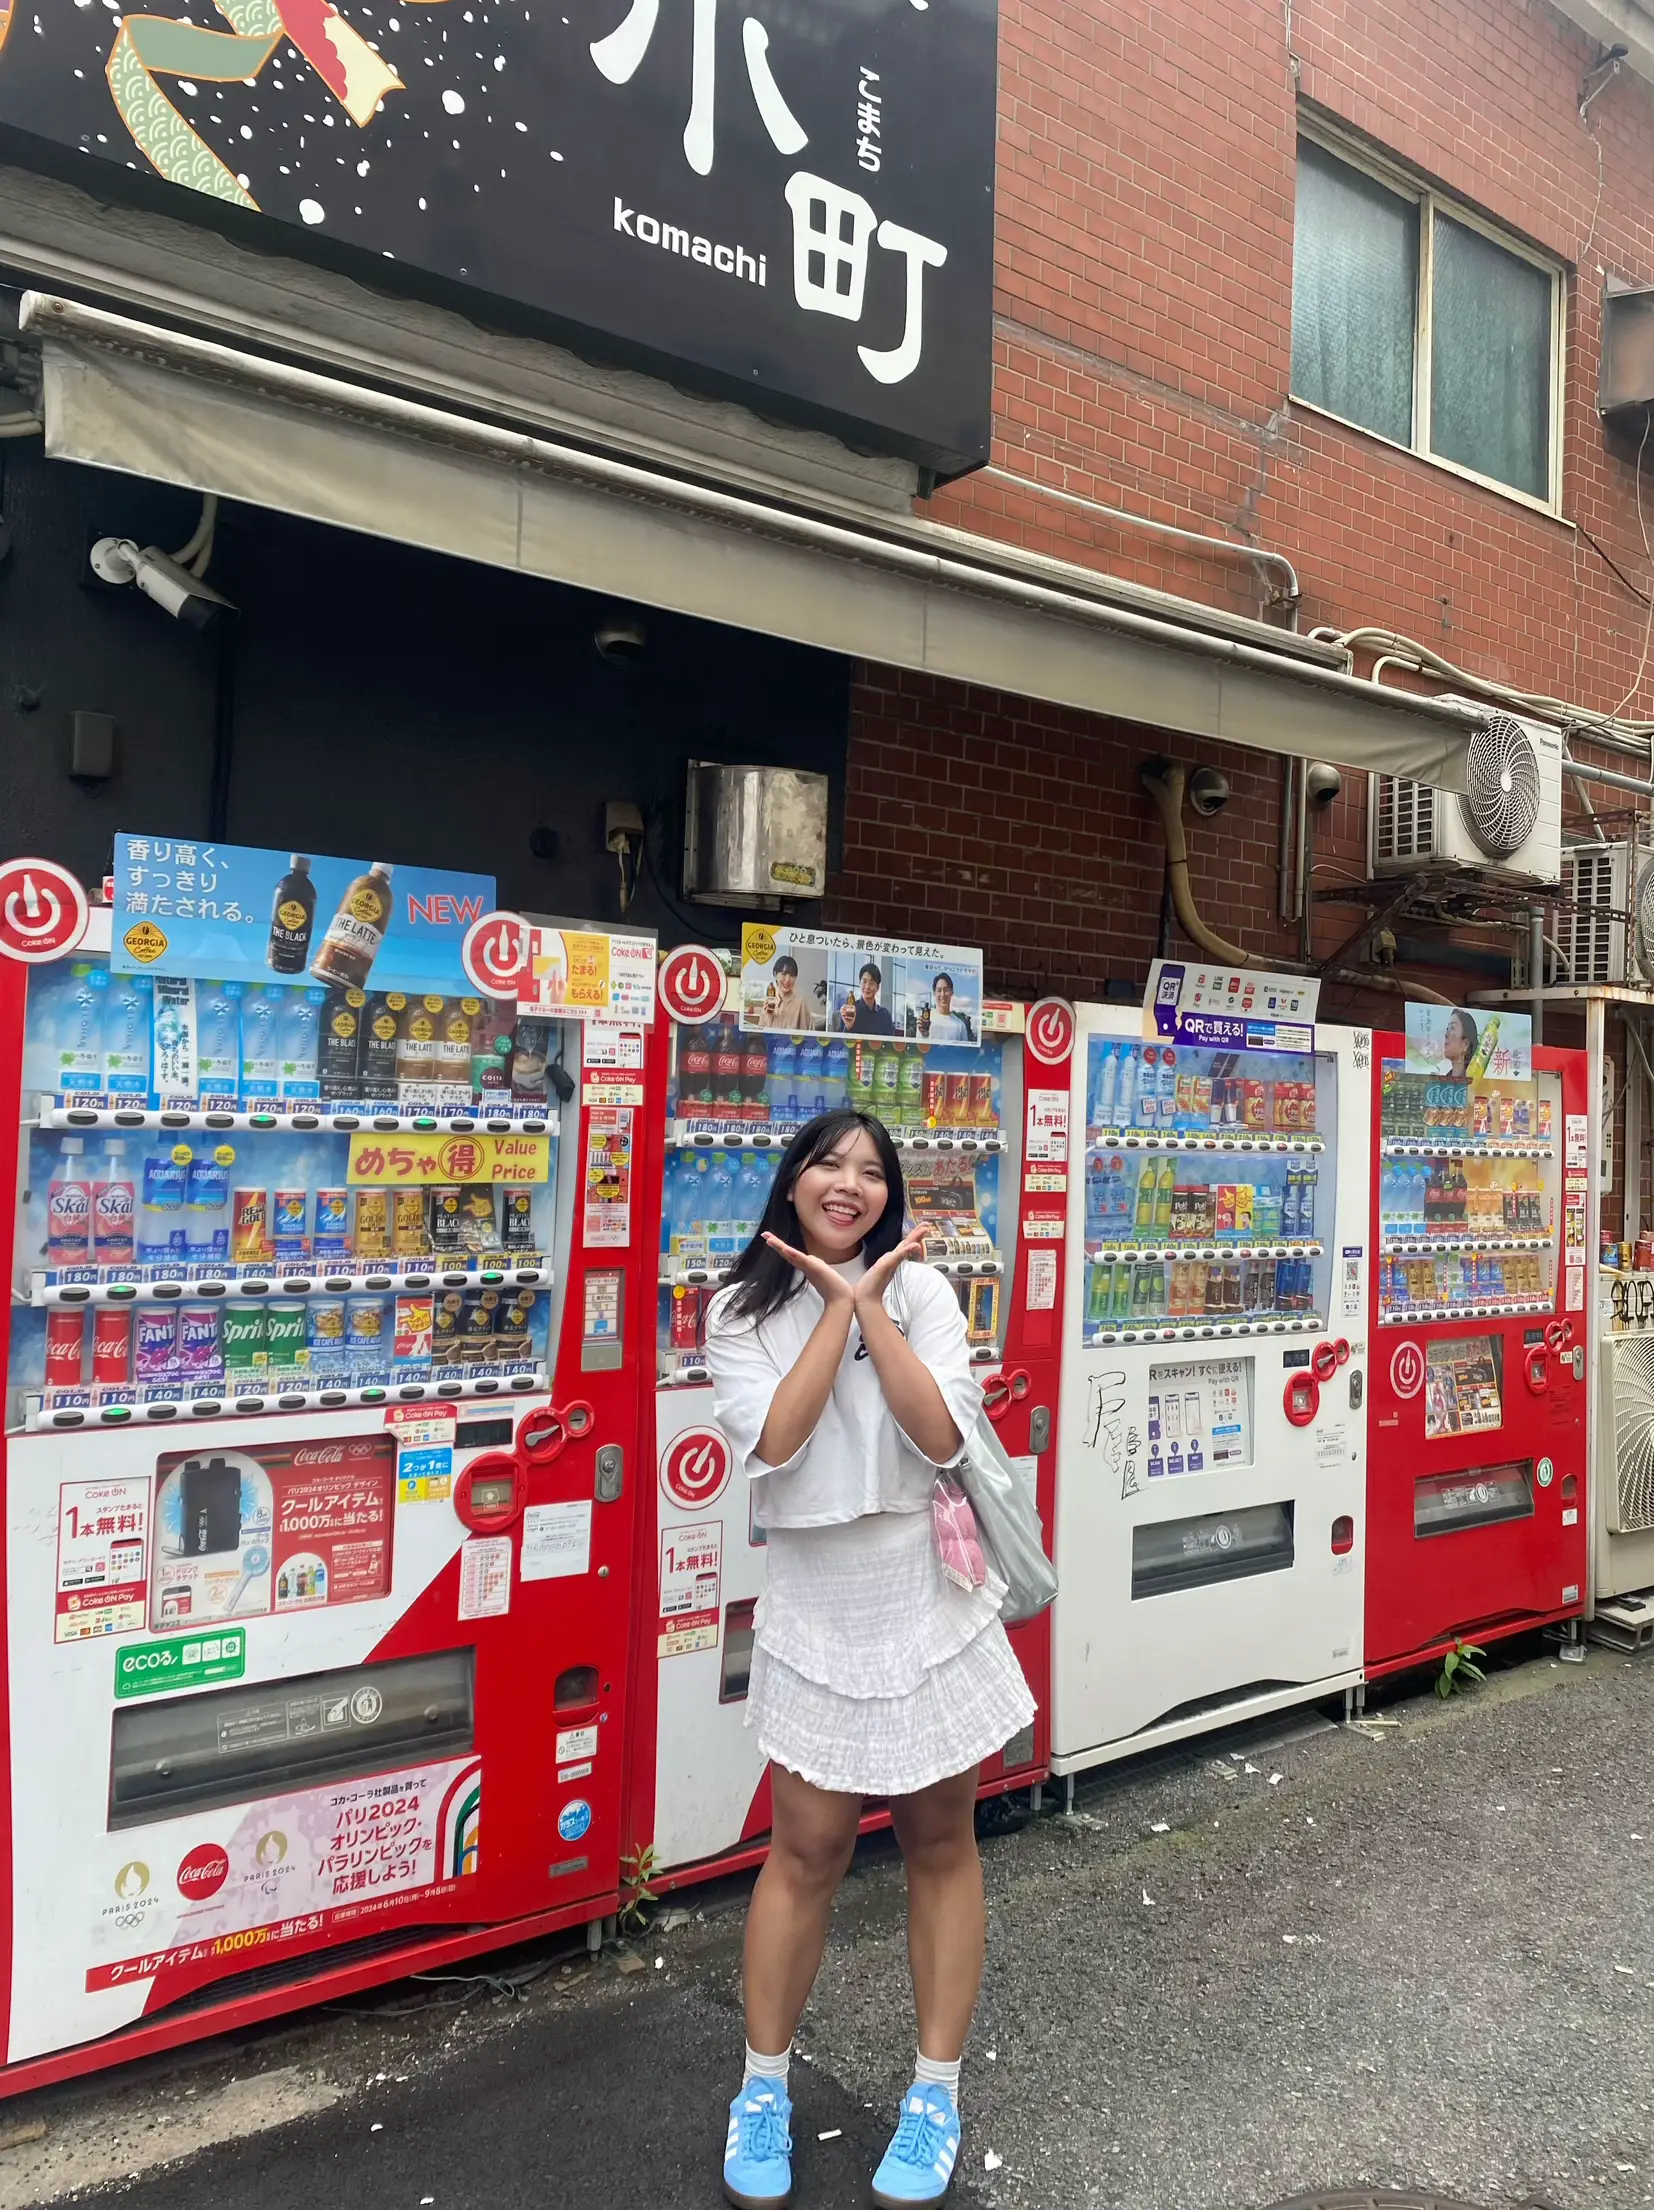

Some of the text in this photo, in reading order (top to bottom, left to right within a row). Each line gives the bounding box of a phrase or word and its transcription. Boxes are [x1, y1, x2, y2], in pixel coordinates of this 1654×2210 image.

[858, 66, 881, 173] こまち
[612, 197, 768, 288] komachi
[1539, 738, 1559, 750] Panasonic
[126, 839, 228, 870] 香り高く、
[126, 866, 218, 893] すっきり
[125, 891, 255, 925] 満たされる。
[407, 895, 484, 925] NEW
[273, 926, 306, 941] THE BLACK
[335, 918, 376, 944] THE LATTE
[125, 936, 167, 948] GEORGIA
[747, 941, 774, 951] GEORGIA
[789, 933, 945, 959] ひと息ついたら、景色が変わって見えた。
[611, 947, 629, 957] Coke
[572, 965, 597, 975] たまる!
[571, 989, 602, 1000] もらえる!
[1163, 981, 1176, 992] QR
[162, 996, 189, 1006] Water
[1185, 1019, 1244, 1036] QRで買える!
[406, 1043, 417, 1051] THE
[1199, 1035, 1208, 1043] Pay
[1221, 1036, 1229, 1044] QR
[1493, 1048, 1510, 1076] 新
[1030, 1105, 1066, 1128] 1本無料!
[495, 1139, 537, 1155] Value
[492, 1164, 535, 1179] Price
[405, 1410, 422, 1418] Coke
[437, 1409, 448, 1418] Pay
[85, 1487, 126, 1500] Coke ON
[96, 1503, 143, 1513] スタンプたまると
[65, 1506, 143, 1539] 1本無料!
[679, 1534, 694, 1542] Coke
[665, 1547, 718, 1574] 1本無料!
[83, 1596, 103, 1607] Coke
[118, 1592, 133, 1602] Pay
[676, 1620, 690, 1629] Coke
[700, 1618, 711, 1626] Pay
[331, 1779, 427, 1807] コカ・コーラ社製品を買って
[336, 1796, 419, 1829] パリ2024
[330, 1817, 422, 1851] オリンピック・
[318, 1837, 432, 1876] パラリンピックを
[178, 1857, 226, 1886] Coca-Cola
[244, 1864, 296, 1883] PARIS 2024
[332, 1859, 416, 1895] 応援しよう!
[102, 1898, 159, 1916] PARIS 2024
